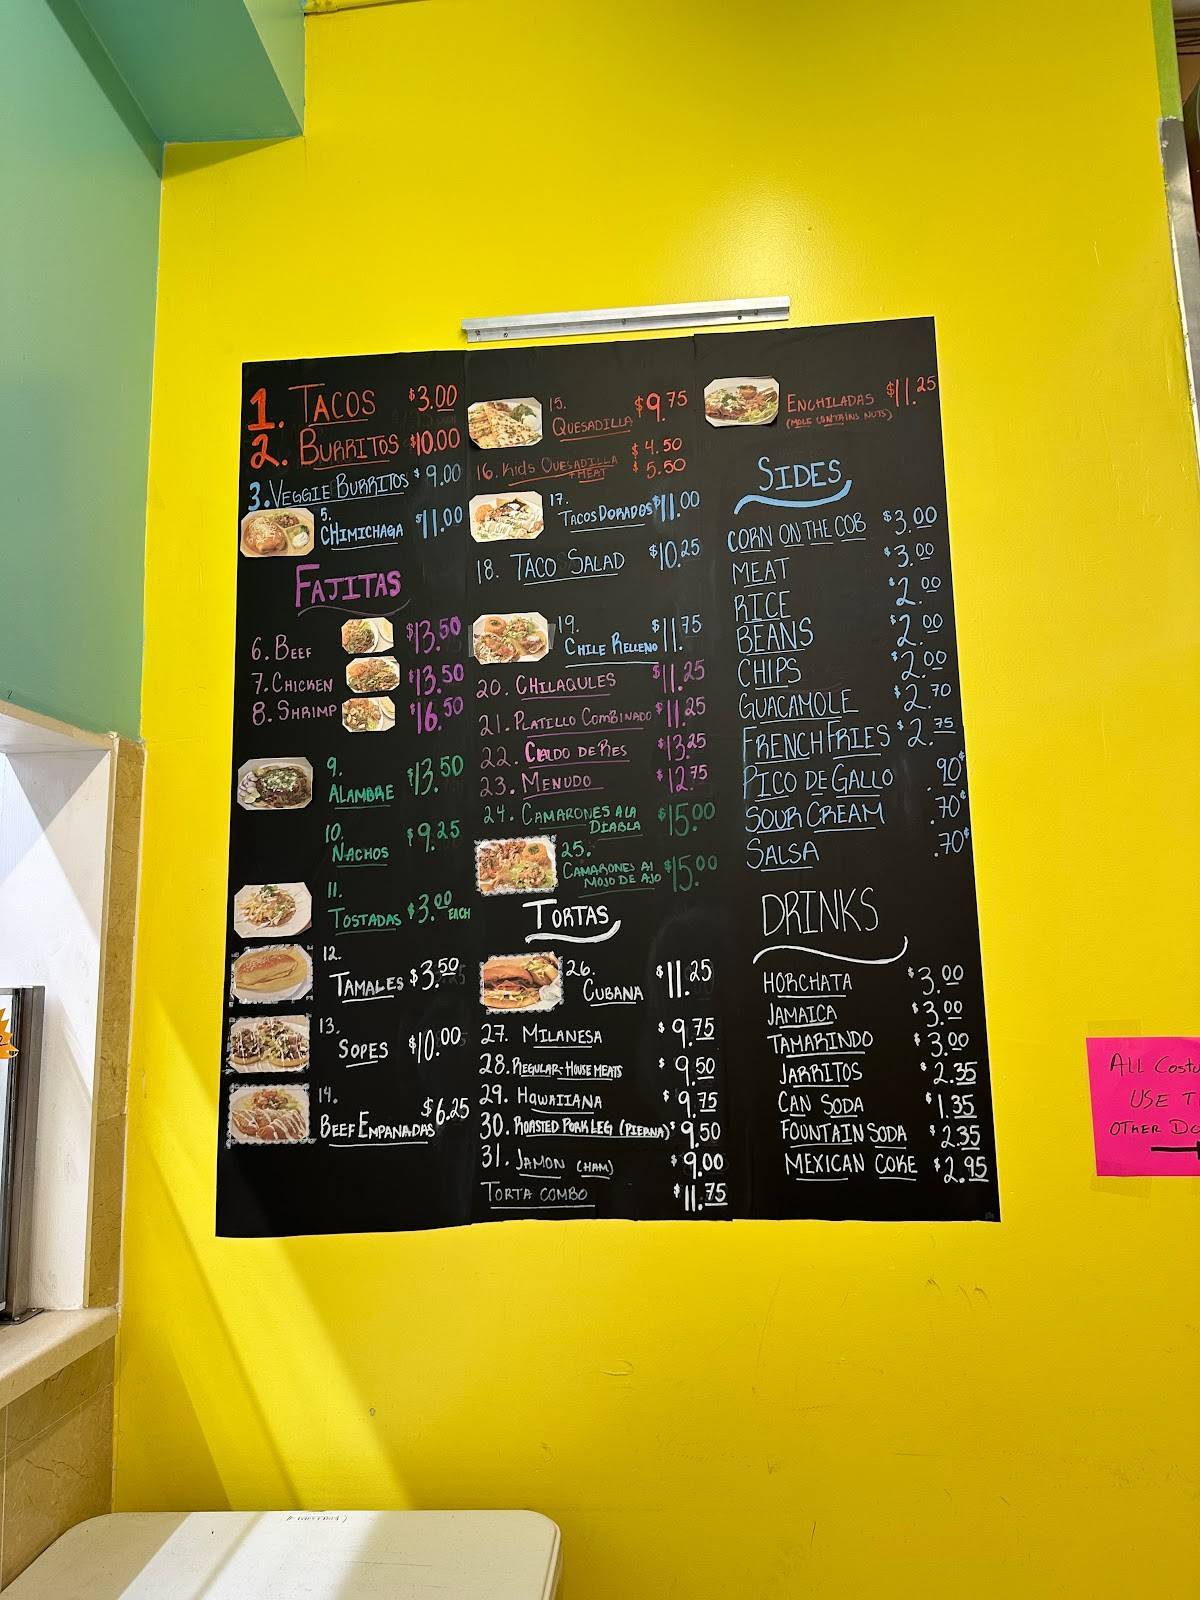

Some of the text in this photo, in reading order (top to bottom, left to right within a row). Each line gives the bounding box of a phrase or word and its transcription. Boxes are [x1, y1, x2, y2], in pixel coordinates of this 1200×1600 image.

[288, 383, 376, 422] TACOS
[409, 384, 457, 412] $3.00
[787, 376, 936, 412] ENCHILADAS $11.25
[552, 391, 688, 436] QUESADILLA $9.75
[300, 428, 400, 465] BURRITOS
[410, 427, 460, 456] $10.00
[541, 456, 618, 472] QUESADILLA
[758, 456, 841, 491] SIDES
[269, 480, 331, 507] VEGGIE
[335, 473, 409, 498] BURRITOS
[414, 464, 461, 487] $9.00
[416, 506, 462, 539] $11.00
[558, 490, 700, 526] TACOS DORADOS $11.00
[728, 506, 937, 552] CORN ON THE COB $3.00
[510, 552, 556, 581] TACO
[568, 549, 625, 574] SALAD
[649, 538, 700, 570] $10.25
[732, 542, 934, 584] MEAT $3.00
[295, 564, 401, 607] FAJITAS
[734, 576, 941, 621] RICE $2.00
[275, 635, 311, 660] BEEF
[406, 616, 461, 654] $13.50
[565, 614, 702, 656] CHILE RELLENO $11.75
[737, 613, 943, 654] BEANS $2.00
[272, 672, 333, 693] CHICKEN
[409, 664, 464, 695] $13.50
[652, 659, 705, 693] $11.25
[738, 650, 946, 687] CHIPS $2.00
[278, 700, 337, 720] SHRIMP
[410, 697, 464, 734] $16.50
[514, 711, 576, 731] PLATILLO
[656, 697, 706, 728] $11.25
[739, 683, 951, 720] GUACAMOLE $2.70
[578, 746, 594, 758] DE
[598, 739, 627, 756] RES
[658, 733, 706, 761] $13.25
[743, 717, 954, 761] FRENCH FRIES $2.75
[407, 755, 464, 795] $13.50
[521, 765, 708, 793] MENUDO $12.75
[743, 763, 893, 799] PICO DE GALLO
[522, 803, 610, 825] CAMARONES
[658, 802, 715, 836] $15.00
[590, 820, 641, 834] DIABLA
[746, 802, 885, 832] SOUR CREAM
[332, 820, 460, 863] NACHOS $9.25
[747, 838, 819, 869] SALSA
[563, 855, 717, 892] CAMARONES $15.00
[584, 873, 661, 888] MOJO DE AJO
[328, 891, 471, 928] TOSTADAS $3.00 EACH
[522, 899, 609, 929] TORTAS
[762, 887, 878, 936] DRINKS
[329, 958, 459, 996] TAMALES $3.50
[583, 959, 712, 1001] CUBANA $11.25
[764, 965, 964, 995] HORCHATA $3.00
[768, 1000, 962, 1027] JAMAICA $3.00
[339, 1027, 461, 1063] SOPES $10.00
[522, 1024, 602, 1044] MILANESA
[658, 1017, 714, 1049] $9.75
[767, 1030, 969, 1057] TAMARINDO $3.00
[594, 1064, 623, 1078] MEATS
[659, 1055, 715, 1086] $9.50
[780, 1061, 977, 1084] JARRITOS $2.35
[663, 1090, 718, 1118] $9.75
[778, 1091, 975, 1119] CAN SODA $1.35
[1130, 1089, 1168, 1109] USE
[321, 1097, 469, 1139] BEEF EMPANADAS $6.25
[514, 1116, 559, 1136] ROASTED
[563, 1118, 590, 1133] PORK
[591, 1119, 613, 1135] LEG
[670, 1121, 720, 1149] $9.50
[781, 1119, 980, 1148] FOUNTAIN SODA $2.35
[516, 1148, 565, 1170] JAMON
[577, 1160, 614, 1175] (HAM)
[671, 1151, 723, 1179] $9.00
[785, 1153, 988, 1183] MEXICAN COKE $2.95
[481, 1181, 726, 1211] TORTA COMBO $11.75
